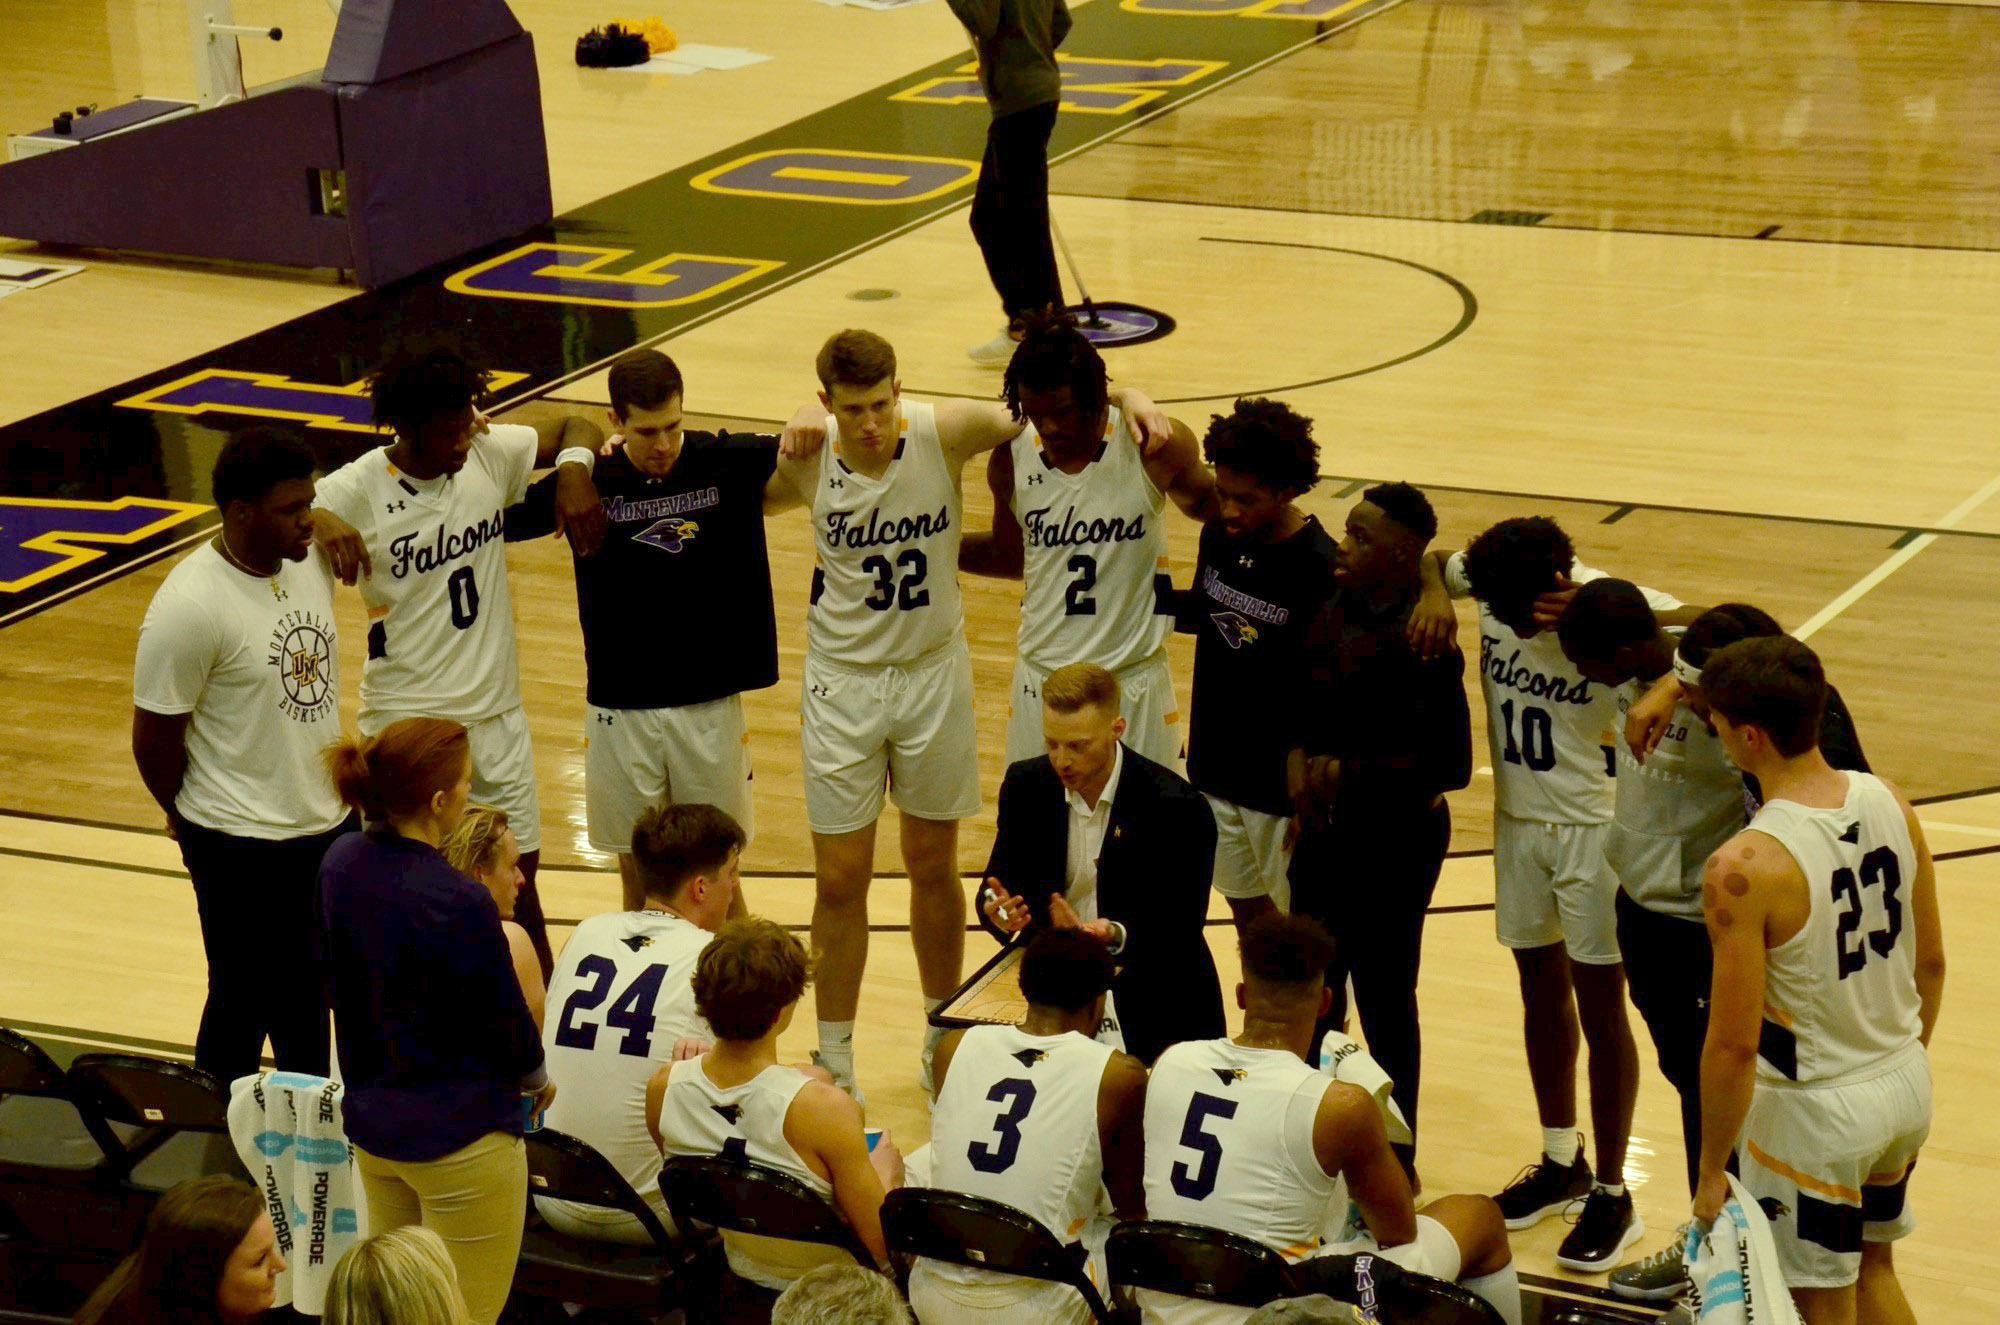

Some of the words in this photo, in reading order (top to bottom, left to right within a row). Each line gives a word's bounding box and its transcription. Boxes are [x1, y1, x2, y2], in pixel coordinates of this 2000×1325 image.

[600, 486, 720, 522] MONTEVALLO
[826, 505, 950, 549] Falcons
[1024, 505, 1146, 548] Falcons
[389, 509, 504, 579] Falcons
[447, 565, 480, 630] 0
[861, 548, 930, 611] 32
[1065, 554, 1097, 616] 2
[1203, 564, 1289, 626] MONTEVALLO
[267, 609, 337, 667] MONTEVALLO
[1480, 634, 1594, 706] Falcons
[1500, 698, 1557, 772] 10
[1830, 845, 1903, 981] 23
[554, 953, 670, 1058] 24
[966, 1077, 1038, 1175] 3
[1169, 1090, 1240, 1202] 5
[308, 1171, 329, 1267] POWERADE
